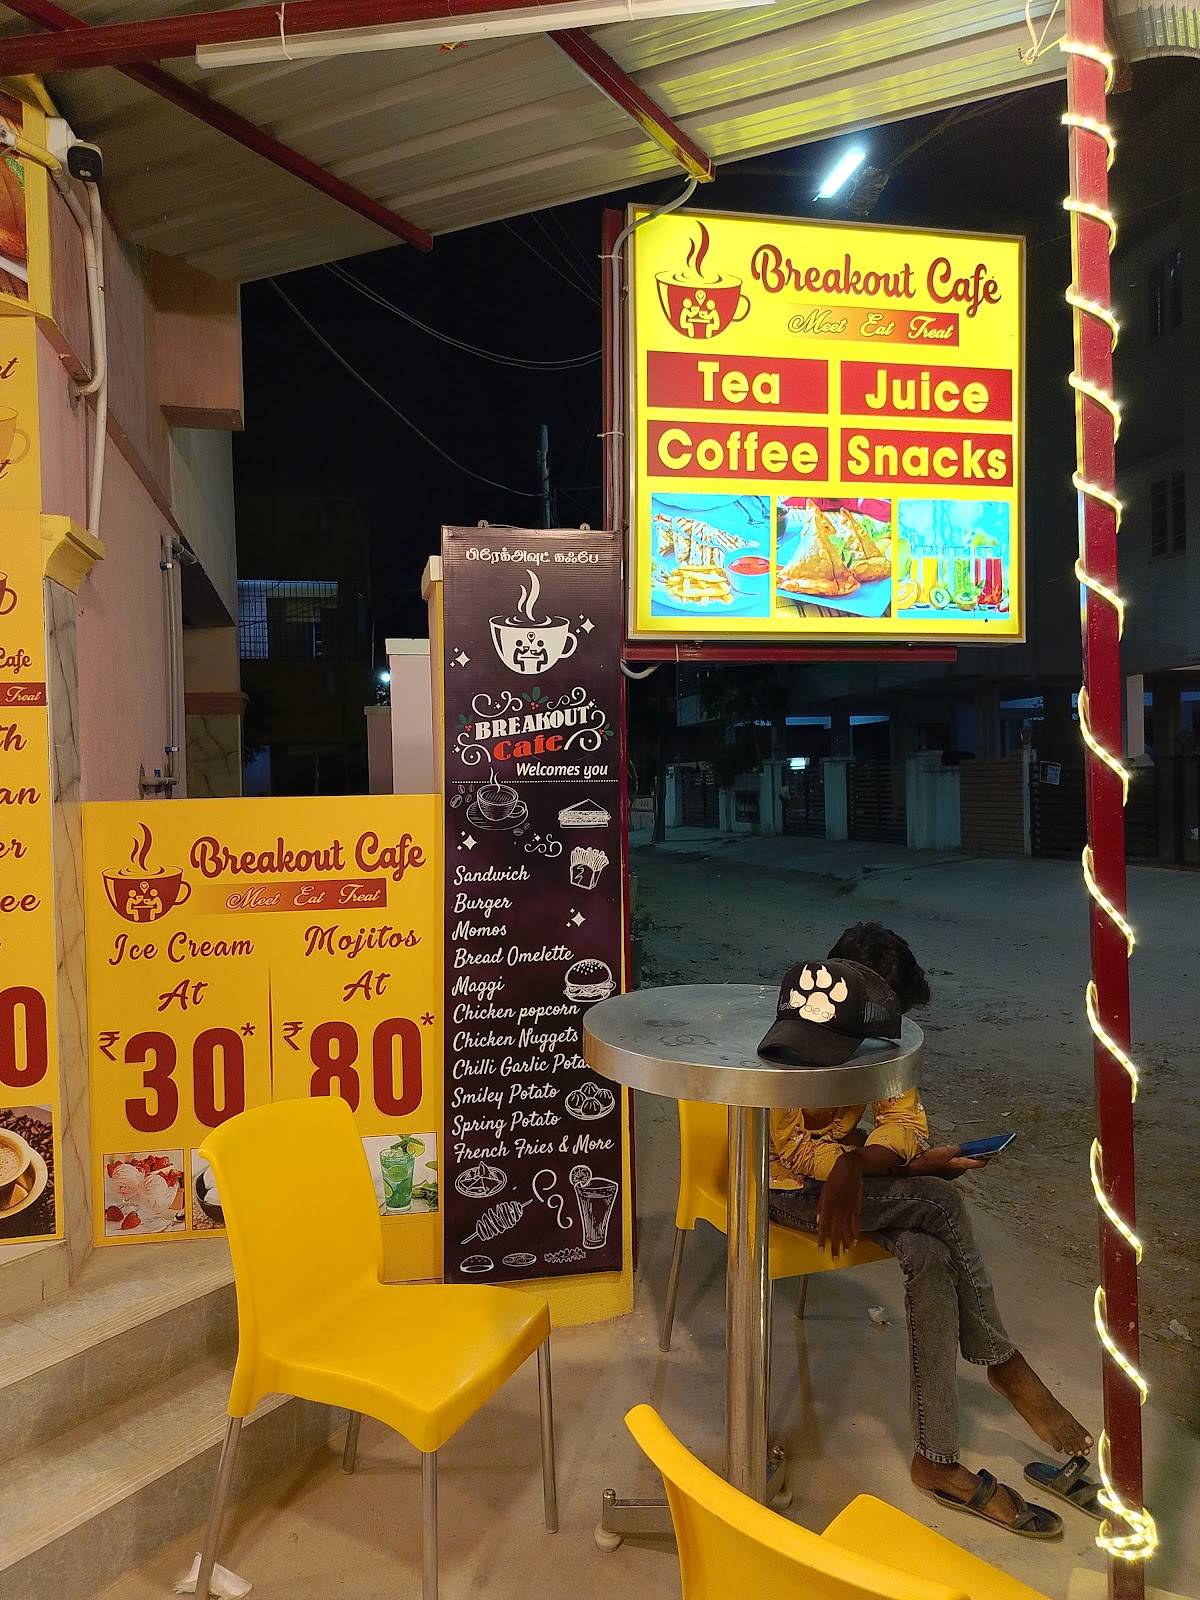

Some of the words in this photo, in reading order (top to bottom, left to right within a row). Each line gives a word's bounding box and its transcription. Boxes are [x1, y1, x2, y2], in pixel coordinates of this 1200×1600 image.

[751, 243, 916, 298] Breakout
[927, 256, 1002, 318] Cafe
[788, 309, 848, 334] Meet
[860, 313, 896, 337] Eat
[907, 315, 954, 340] Treat
[697, 361, 780, 404] Tea
[865, 369, 989, 414] Juice
[658, 428, 819, 474] Coffee
[847, 435, 1007, 480] Snacks
[5, 685, 42, 703] Treat
[475, 705, 590, 741] BREAKOUT
[493, 734, 563, 761] Cafe
[516, 762, 580, 777] Welcomes
[583, 764, 608, 780] you
[189, 836, 345, 878] Breakout
[355, 831, 427, 881] Cafe
[453, 865, 530, 885] Sandwich
[225, 886, 281, 909] Meet
[293, 885, 326, 906] Eat
[338, 883, 381, 904] Treat
[454, 893, 512, 918] Burger
[305, 924, 421, 958] Mojitos
[451, 920, 506, 941] Momos
[109, 933, 158, 966] Ice
[168, 931, 255, 963] Cream
[454, 948, 504, 968] Bread
[507, 945, 574, 966] Omelette
[158, 979, 208, 1011] At
[343, 969, 391, 1002] At
[451, 976, 505, 1001] Maggi
[453, 1003, 516, 1024] Chicken
[518, 1004, 580, 1025] popcorn
[453, 1031, 516, 1052] Chicken
[518, 1027, 579, 1053] Nuggets
[453, 1059, 496, 1080] Chilli
[500, 1056, 549, 1076] Garlic
[551, 1053, 591, 1074] Pota
[451, 1087, 503, 1109] Smiley
[508, 1083, 560, 1104] Potato
[452, 1115, 507, 1140] Spring
[510, 1110, 561, 1131] Potato
[454, 1141, 510, 1163] French
[514, 1138, 554, 1158] Fries
[558, 1135, 569, 1153] &
[572, 1133, 614, 1154] More
